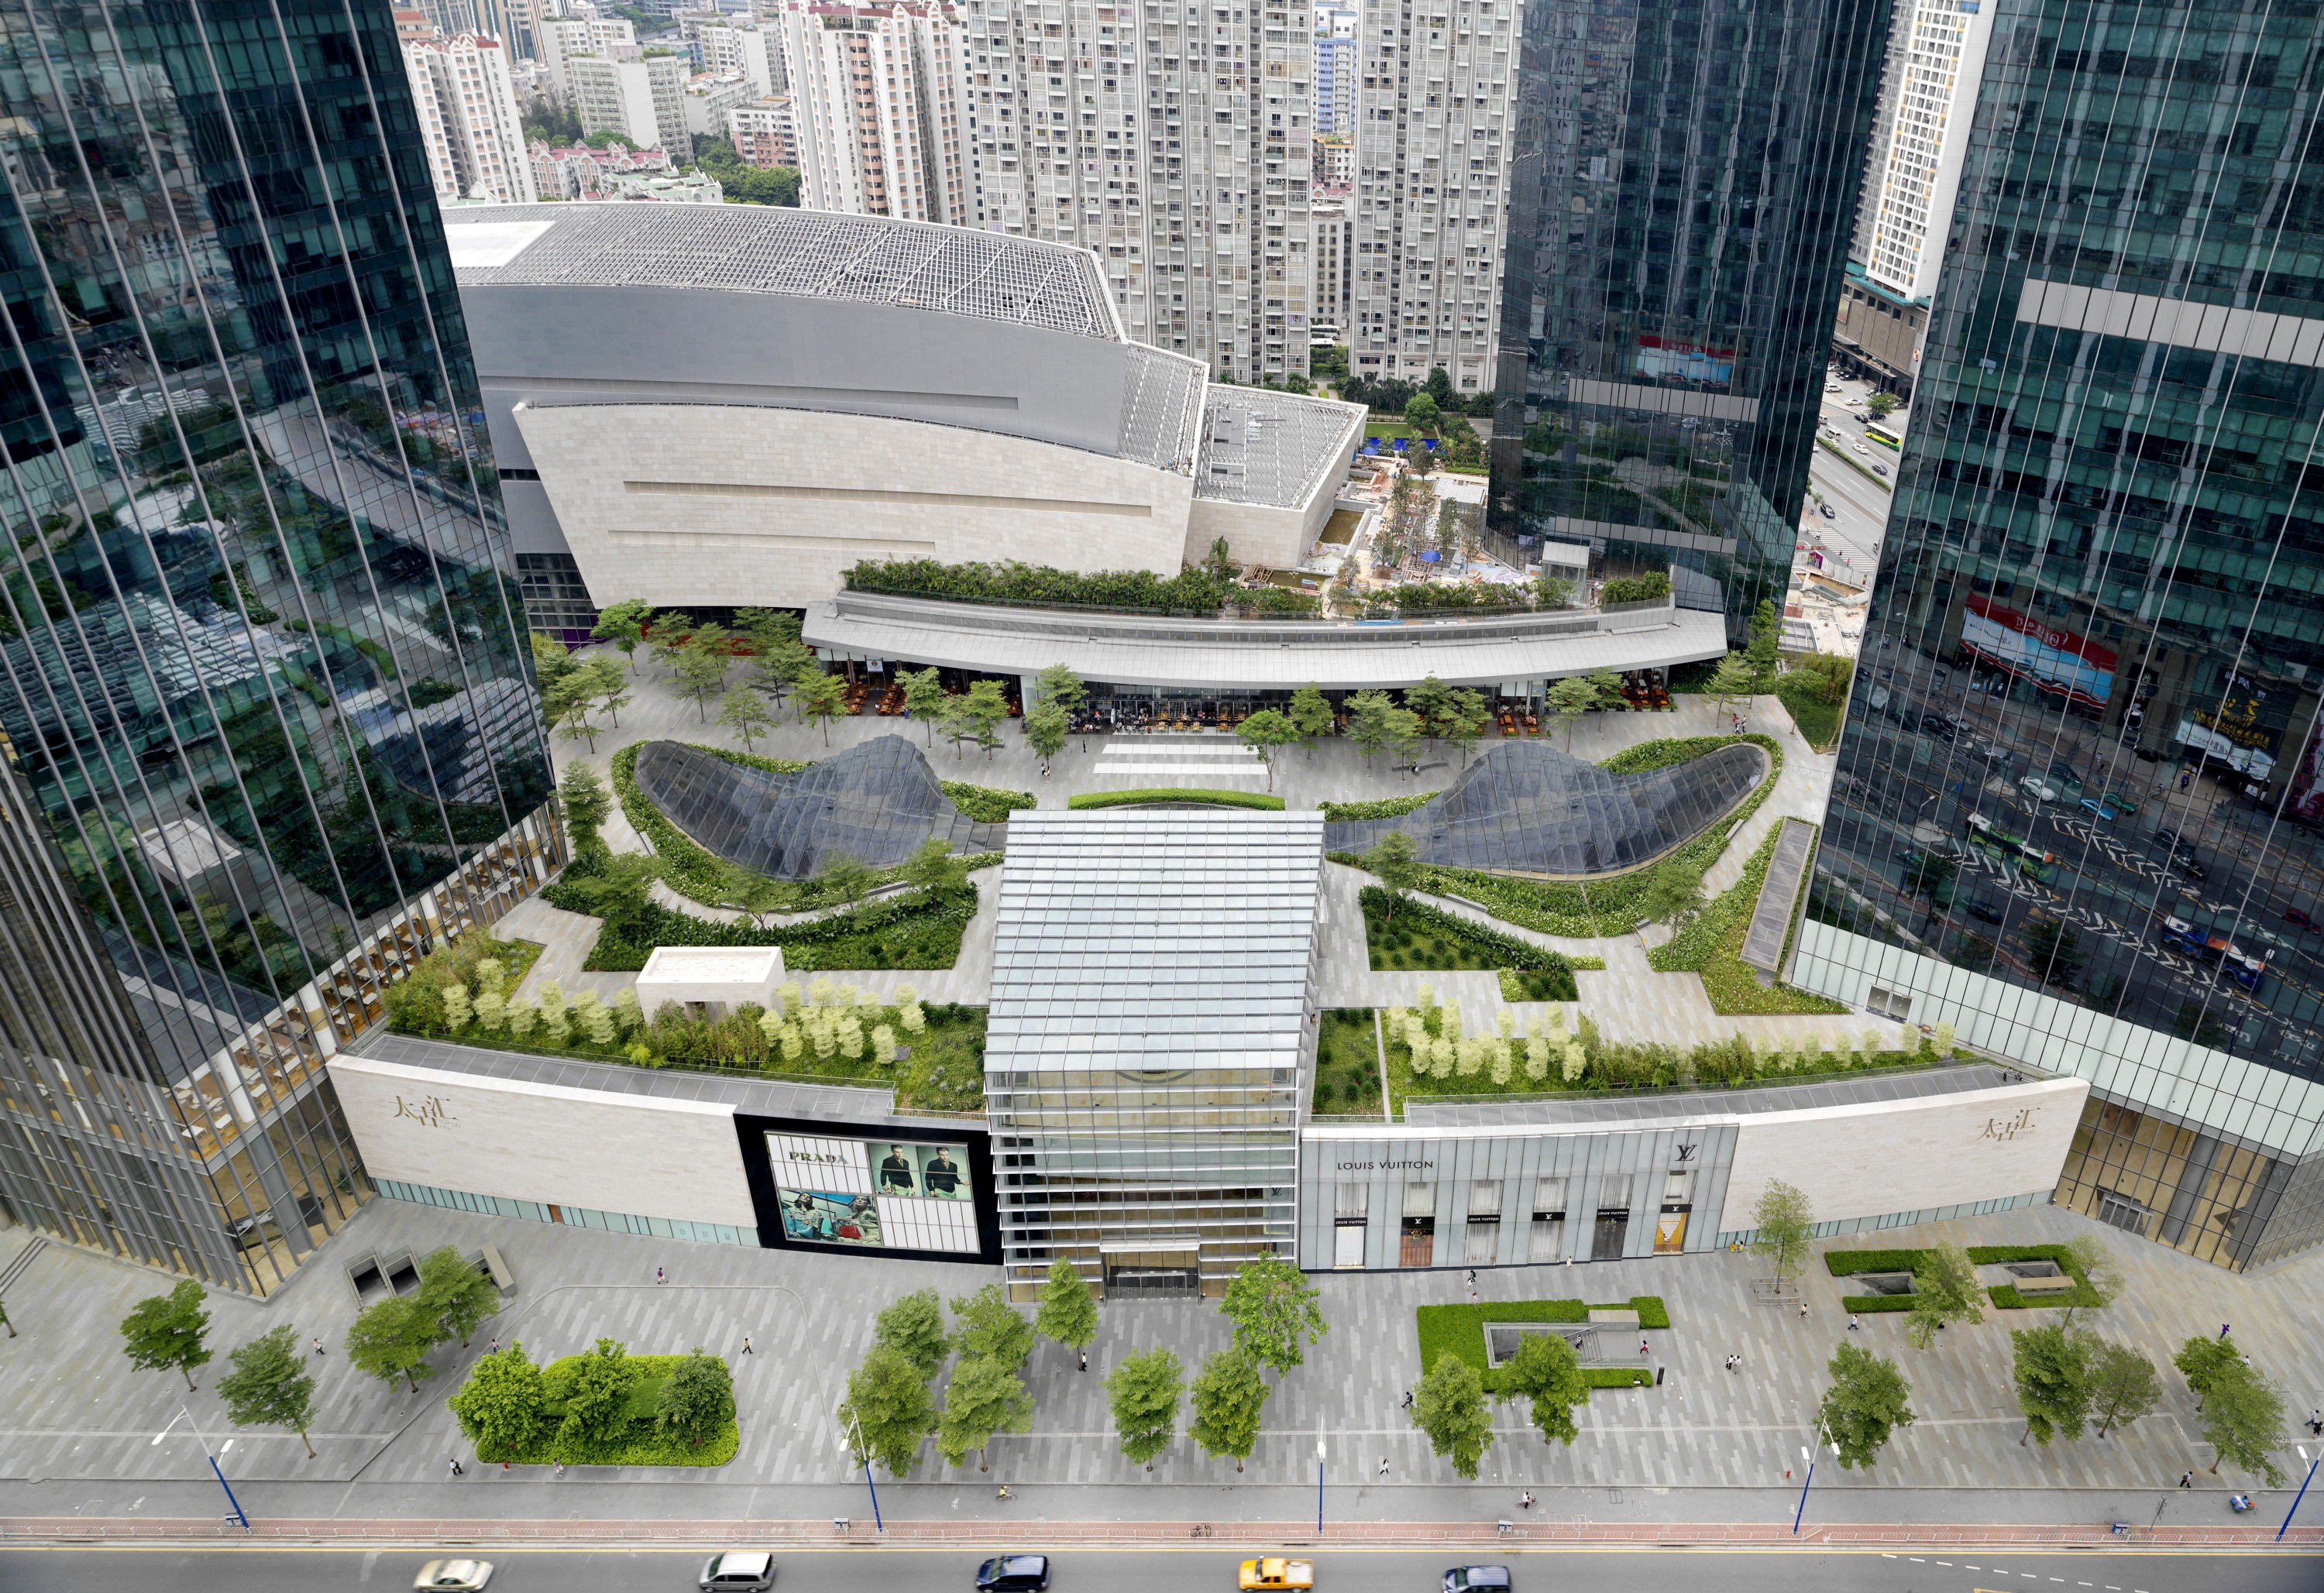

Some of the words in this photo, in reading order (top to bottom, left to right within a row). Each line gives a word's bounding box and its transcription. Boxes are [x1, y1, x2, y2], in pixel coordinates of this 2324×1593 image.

[789, 1150, 849, 1165] PRADA
[1337, 1162, 1374, 1170] LOUIS
[1379, 1161, 1433, 1169] VUITTON
